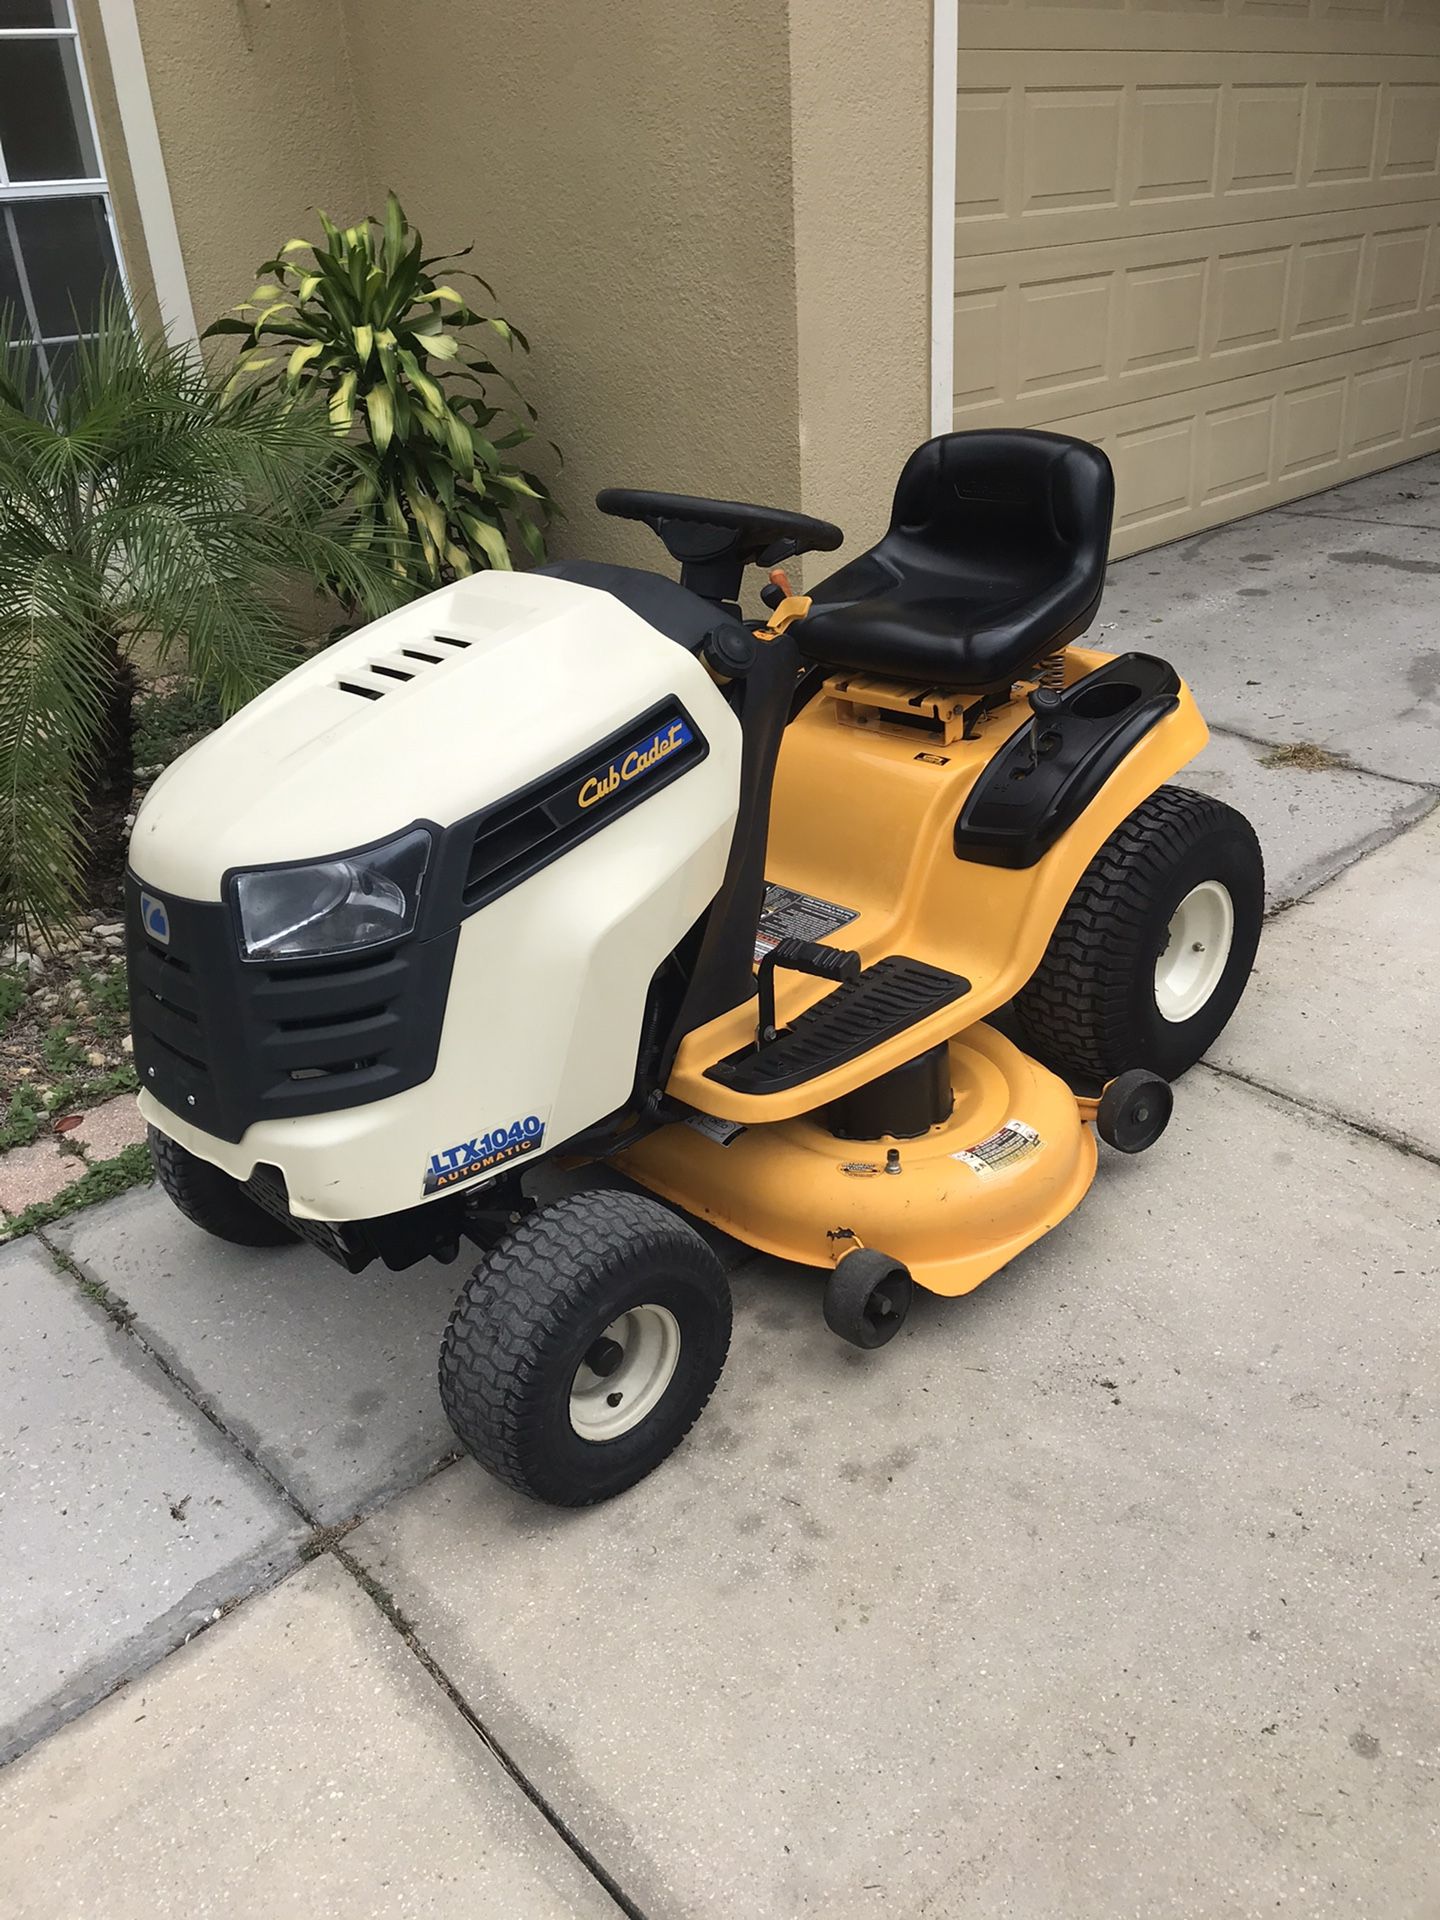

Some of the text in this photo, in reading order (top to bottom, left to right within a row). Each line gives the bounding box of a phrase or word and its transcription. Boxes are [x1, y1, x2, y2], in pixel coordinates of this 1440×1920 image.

[578, 723, 683, 808] Cub Cadet
[430, 1115, 541, 1175] LTX1040
[437, 1140, 532, 1186] AUTOMATIC
